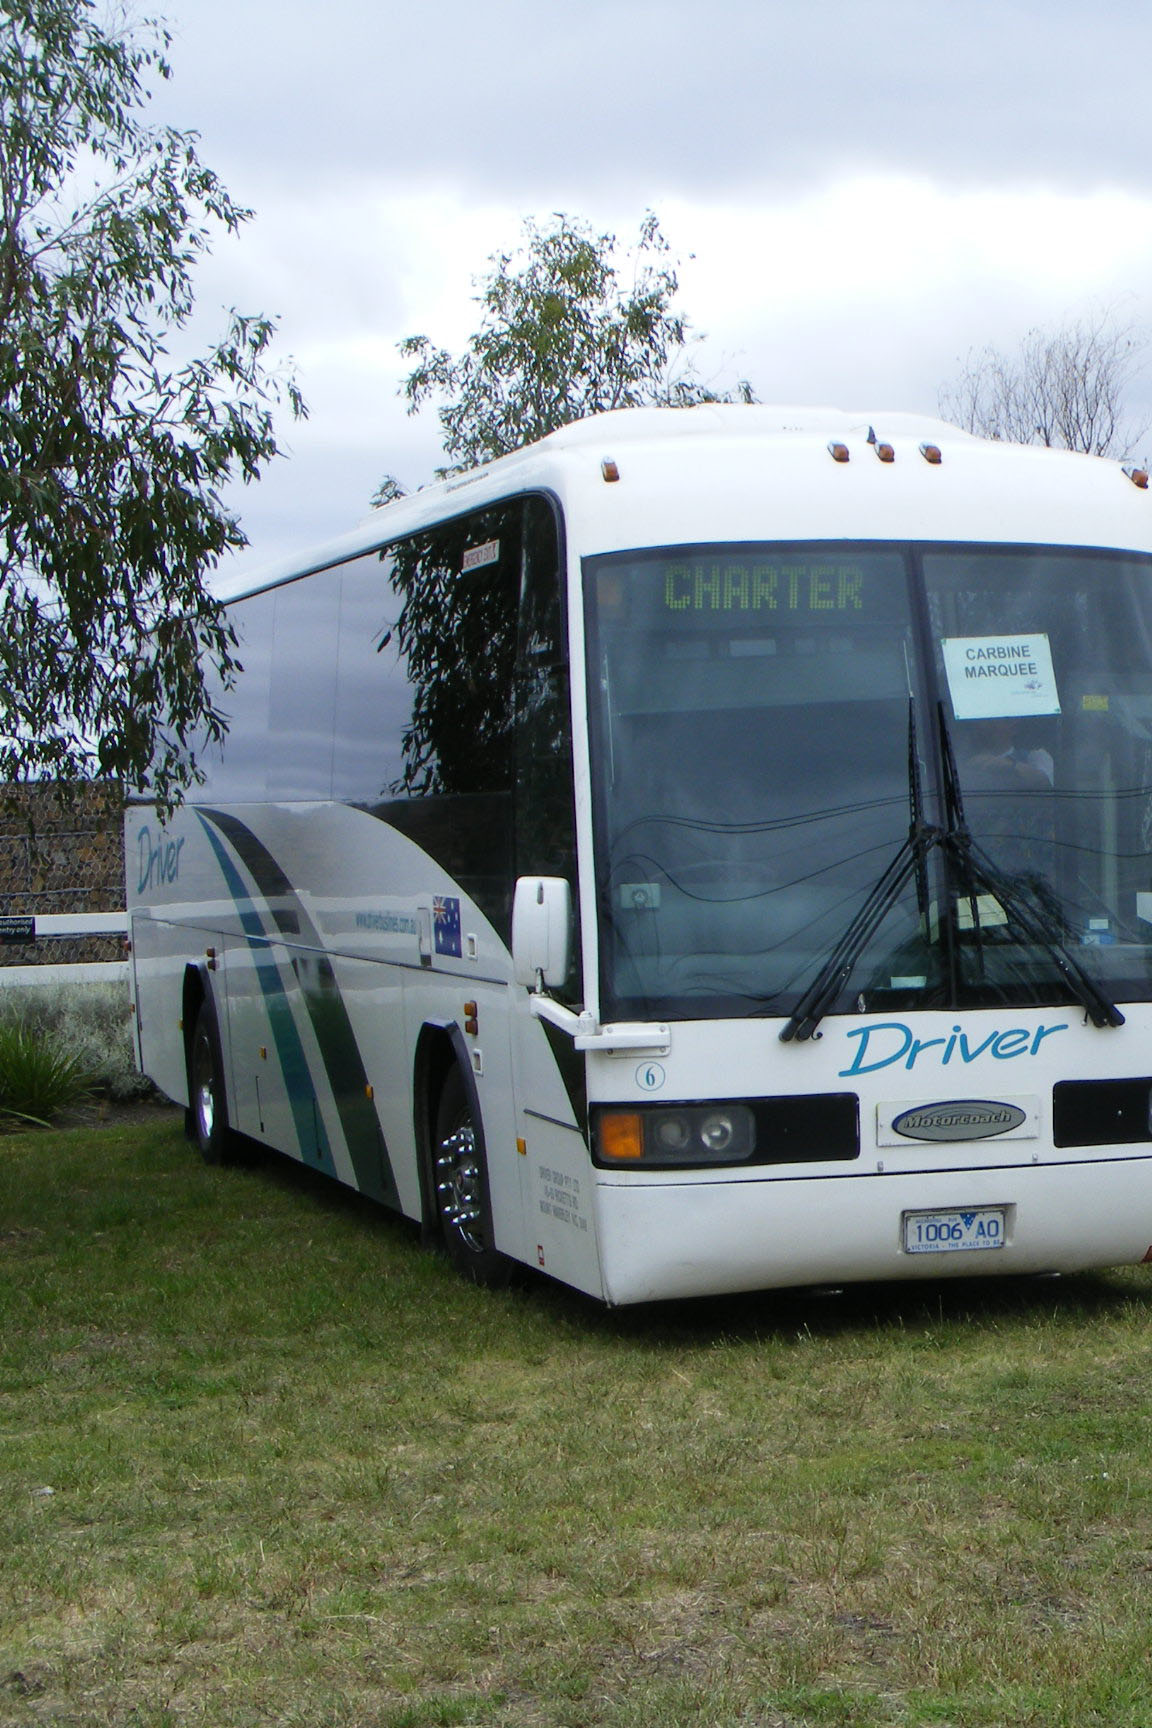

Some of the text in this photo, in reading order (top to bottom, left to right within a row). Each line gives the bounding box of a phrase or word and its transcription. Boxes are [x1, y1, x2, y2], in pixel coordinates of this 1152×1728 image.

[665, 564, 863, 609] CHARTER
[965, 645, 1031, 661] CARBINE
[965, 662, 1038, 679] MARQUEE
[137, 825, 185, 895] Driver
[838, 1022, 1069, 1078] Driver
[904, 1110, 1012, 1129] Motorcoach
[916, 1223, 963, 1242] 1006
